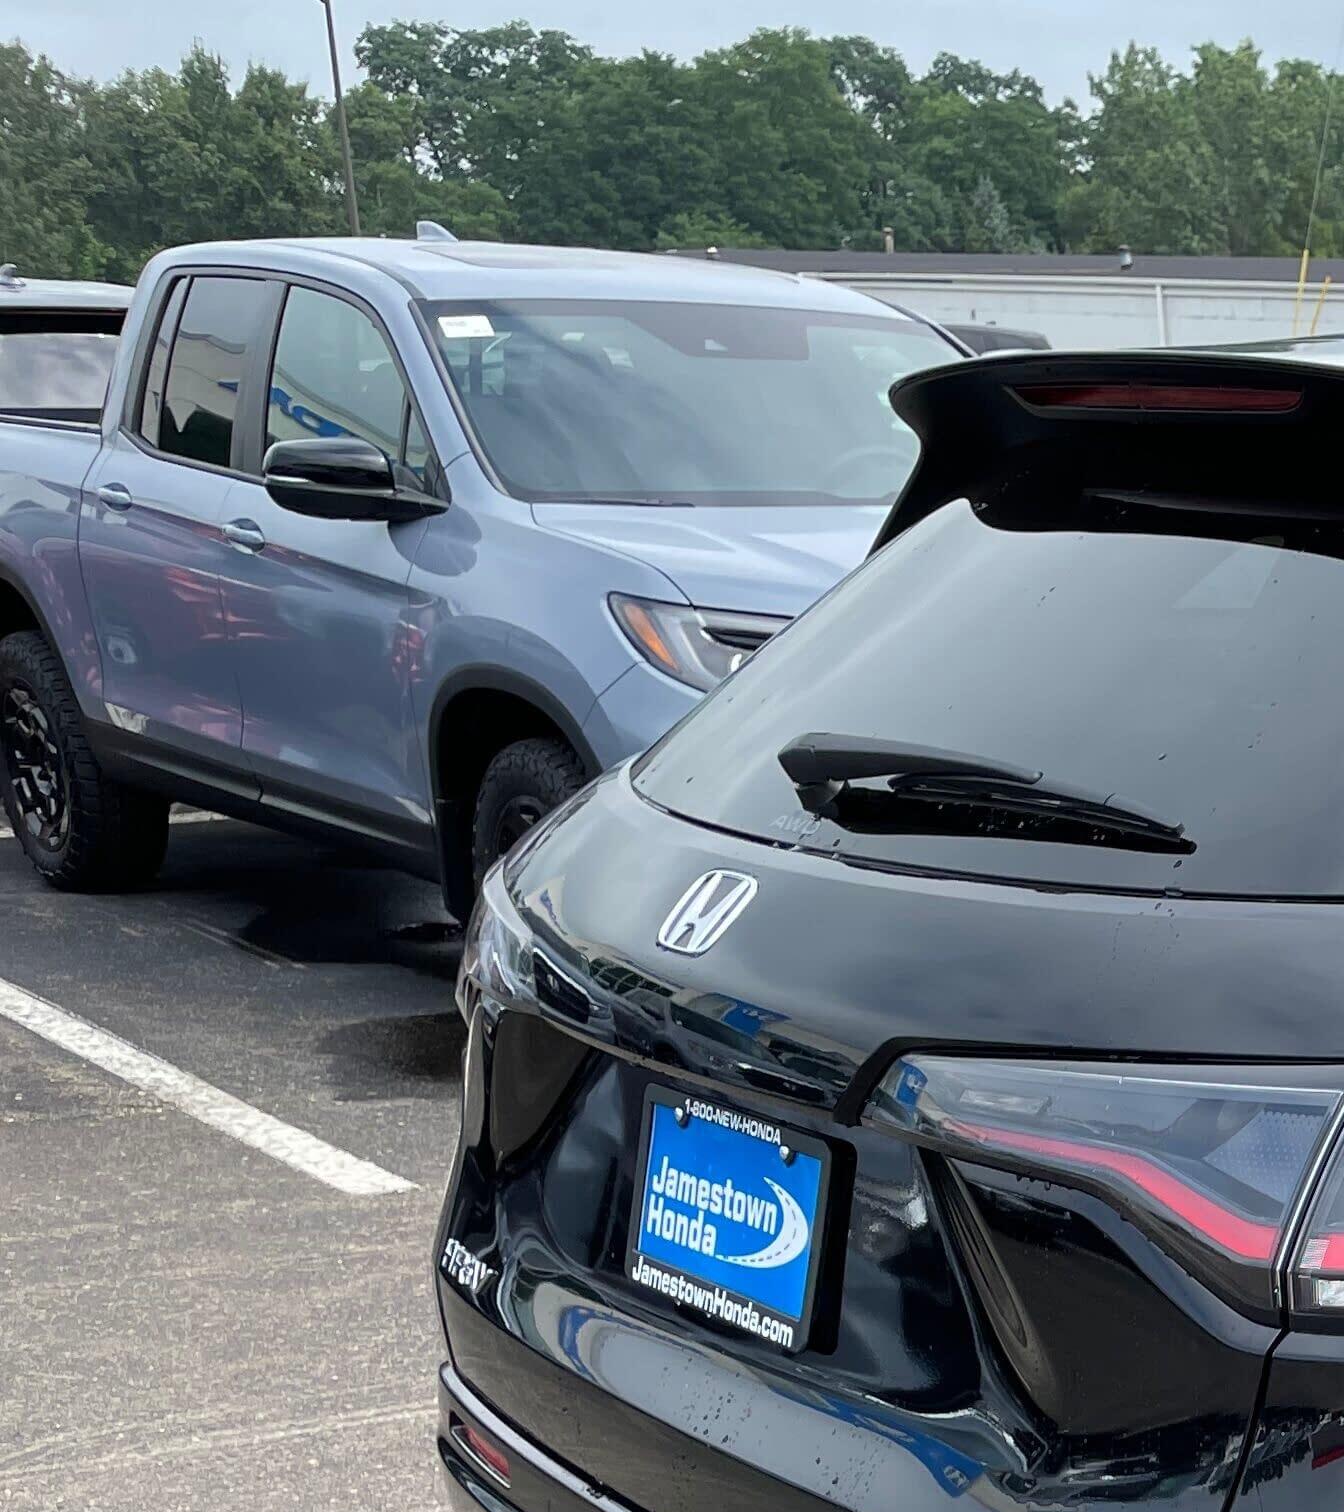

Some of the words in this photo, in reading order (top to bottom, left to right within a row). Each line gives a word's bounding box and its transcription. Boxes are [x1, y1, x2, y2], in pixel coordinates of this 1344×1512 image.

[768, 814, 821, 836] AWD
[684, 1097, 782, 1147] 1-800-NEW-HONDA
[646, 1192, 718, 1258] Honda
[652, 1155, 778, 1236] Jamestown
[631, 1255, 795, 1349] JamestownHonda.com
